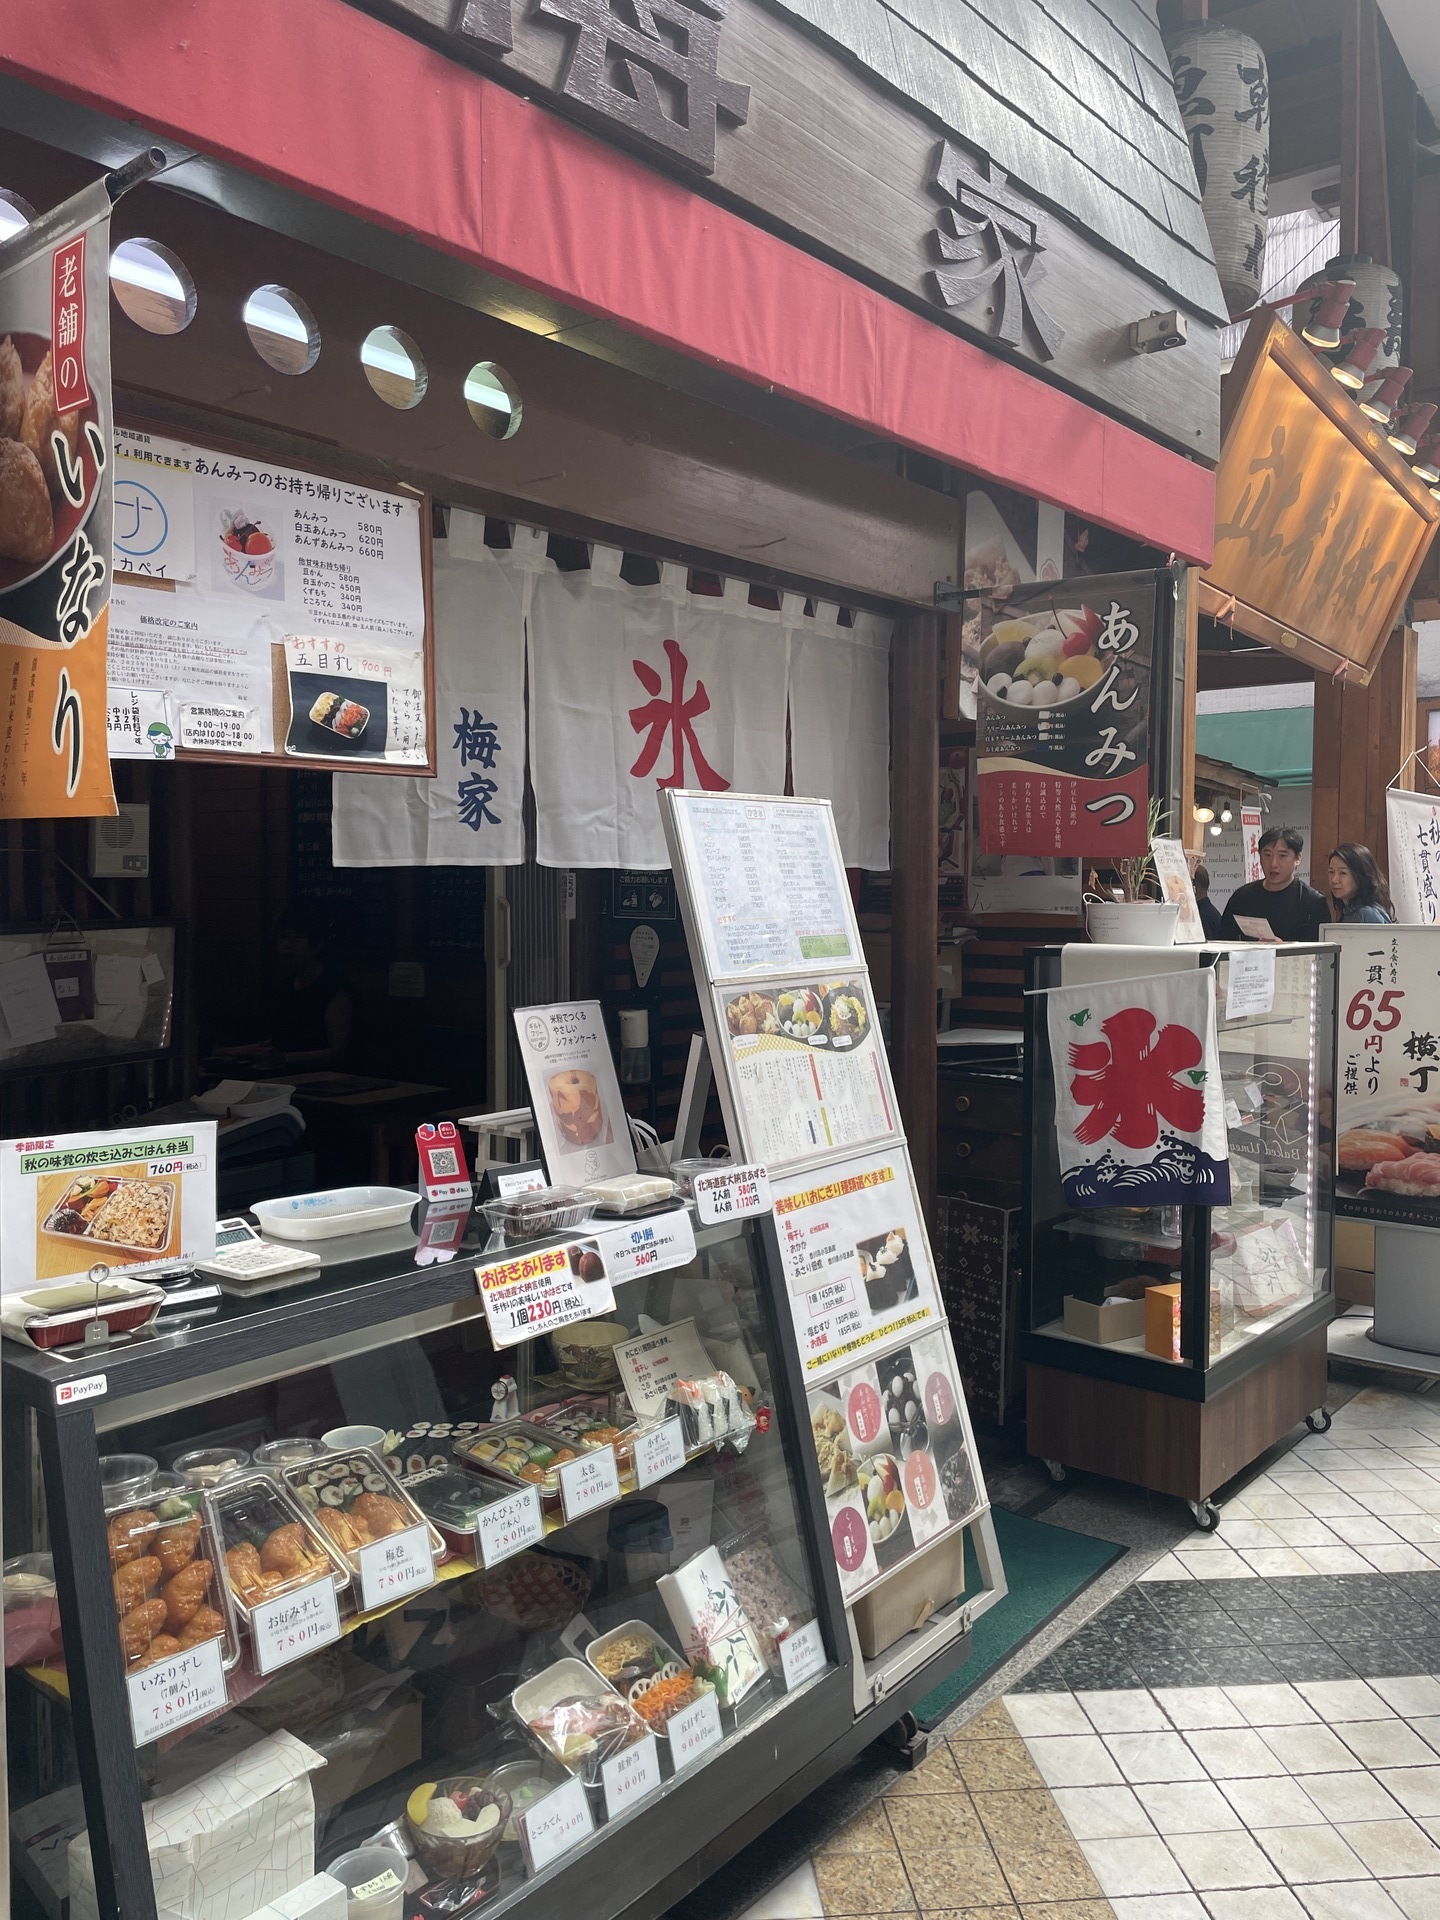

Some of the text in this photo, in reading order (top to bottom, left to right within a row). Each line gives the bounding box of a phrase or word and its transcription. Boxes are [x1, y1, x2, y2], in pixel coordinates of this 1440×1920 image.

[58, 255, 79, 390] 老舗の
[194, 458, 404, 517] あんみつのお持ち帰りございます
[294, 509, 383, 535] あんみつ 580円
[295, 522, 384, 547] 白玉あんみつ 620円
[295, 535, 384, 560] あんずあんみつ 660円
[114, 557, 167, 578] カペイ
[298, 557, 352, 573] 他甘味お持ち帰り
[303, 568, 360, 583] 豆かん 580円
[303, 578, 361, 593] 白玉かのこ 450円
[303, 587, 361, 603] くずもち 340円
[303, 597, 363, 612] ところてん 340円
[51, 421, 105, 798] いなり
[140, 615, 198, 630] 価格改定のご案内
[292, 636, 346, 654] おすすめ
[360, 660, 393, 677] 900円
[190, 707, 245, 718] 営業時間のご案内
[629, 639, 731, 790] 氷
[1085, 601, 1139, 826] あんみつ
[452, 706, 502, 832] 梅家
[1416, 823, 1438, 925] 七貫盛り
[1390, 937, 1399, 985] 立ち食い寿司
[550, 1011, 587, 1024] 米粉でつくる
[553, 1024, 578, 1035] やさしい
[556, 1033, 598, 1046] シフォンケーキ
[1402, 1030, 1440, 1093] 横丁
[1068, 1007, 1207, 1149] 氷
[1344, 1053, 1359, 1097] ご提供
[15, 1139, 55, 1152] 季節限定
[24, 1140, 189, 1171] 秋の味覚の炊き込みごはん弁当
[697, 1167, 768, 1191] 北海道産大納言あずき
[712, 1182, 757, 1201] 2人前 580円
[714, 1201, 733, 1214] 4人前
[630, 1227, 654, 1244] 切り餅
[787, 1229, 805, 1242] 梅干し
[790, 1241, 807, 1254] おかか
[635, 1250, 658, 1266] 560円
[792, 1254, 804, 1265] こぶ
[795, 1259, 823, 1277] あさり佃煮
[480, 1249, 566, 1290] おはぎあります
[489, 1277, 552, 1303] 北海道産大納言使用
[492, 1282, 573, 1314] 手作りの美味しいおはぎです
[807, 1319, 830, 1337] 塩むすび
[810, 1333, 828, 1349] お赤飯
[73, 1380, 104, 1396] PayPay
[581, 1463, 595, 1478] 太巻
[482, 1495, 531, 1528] かんぴょう巻
[385, 1545, 405, 1562] 梅巻
[268, 1596, 322, 1630] お好みずし
[141, 1656, 203, 1691] いなりずし
[617, 1750, 641, 1773] 鮭弁当
[617, 1770, 647, 1795] 800円
[531, 1812, 584, 1840] ところてん 340円
